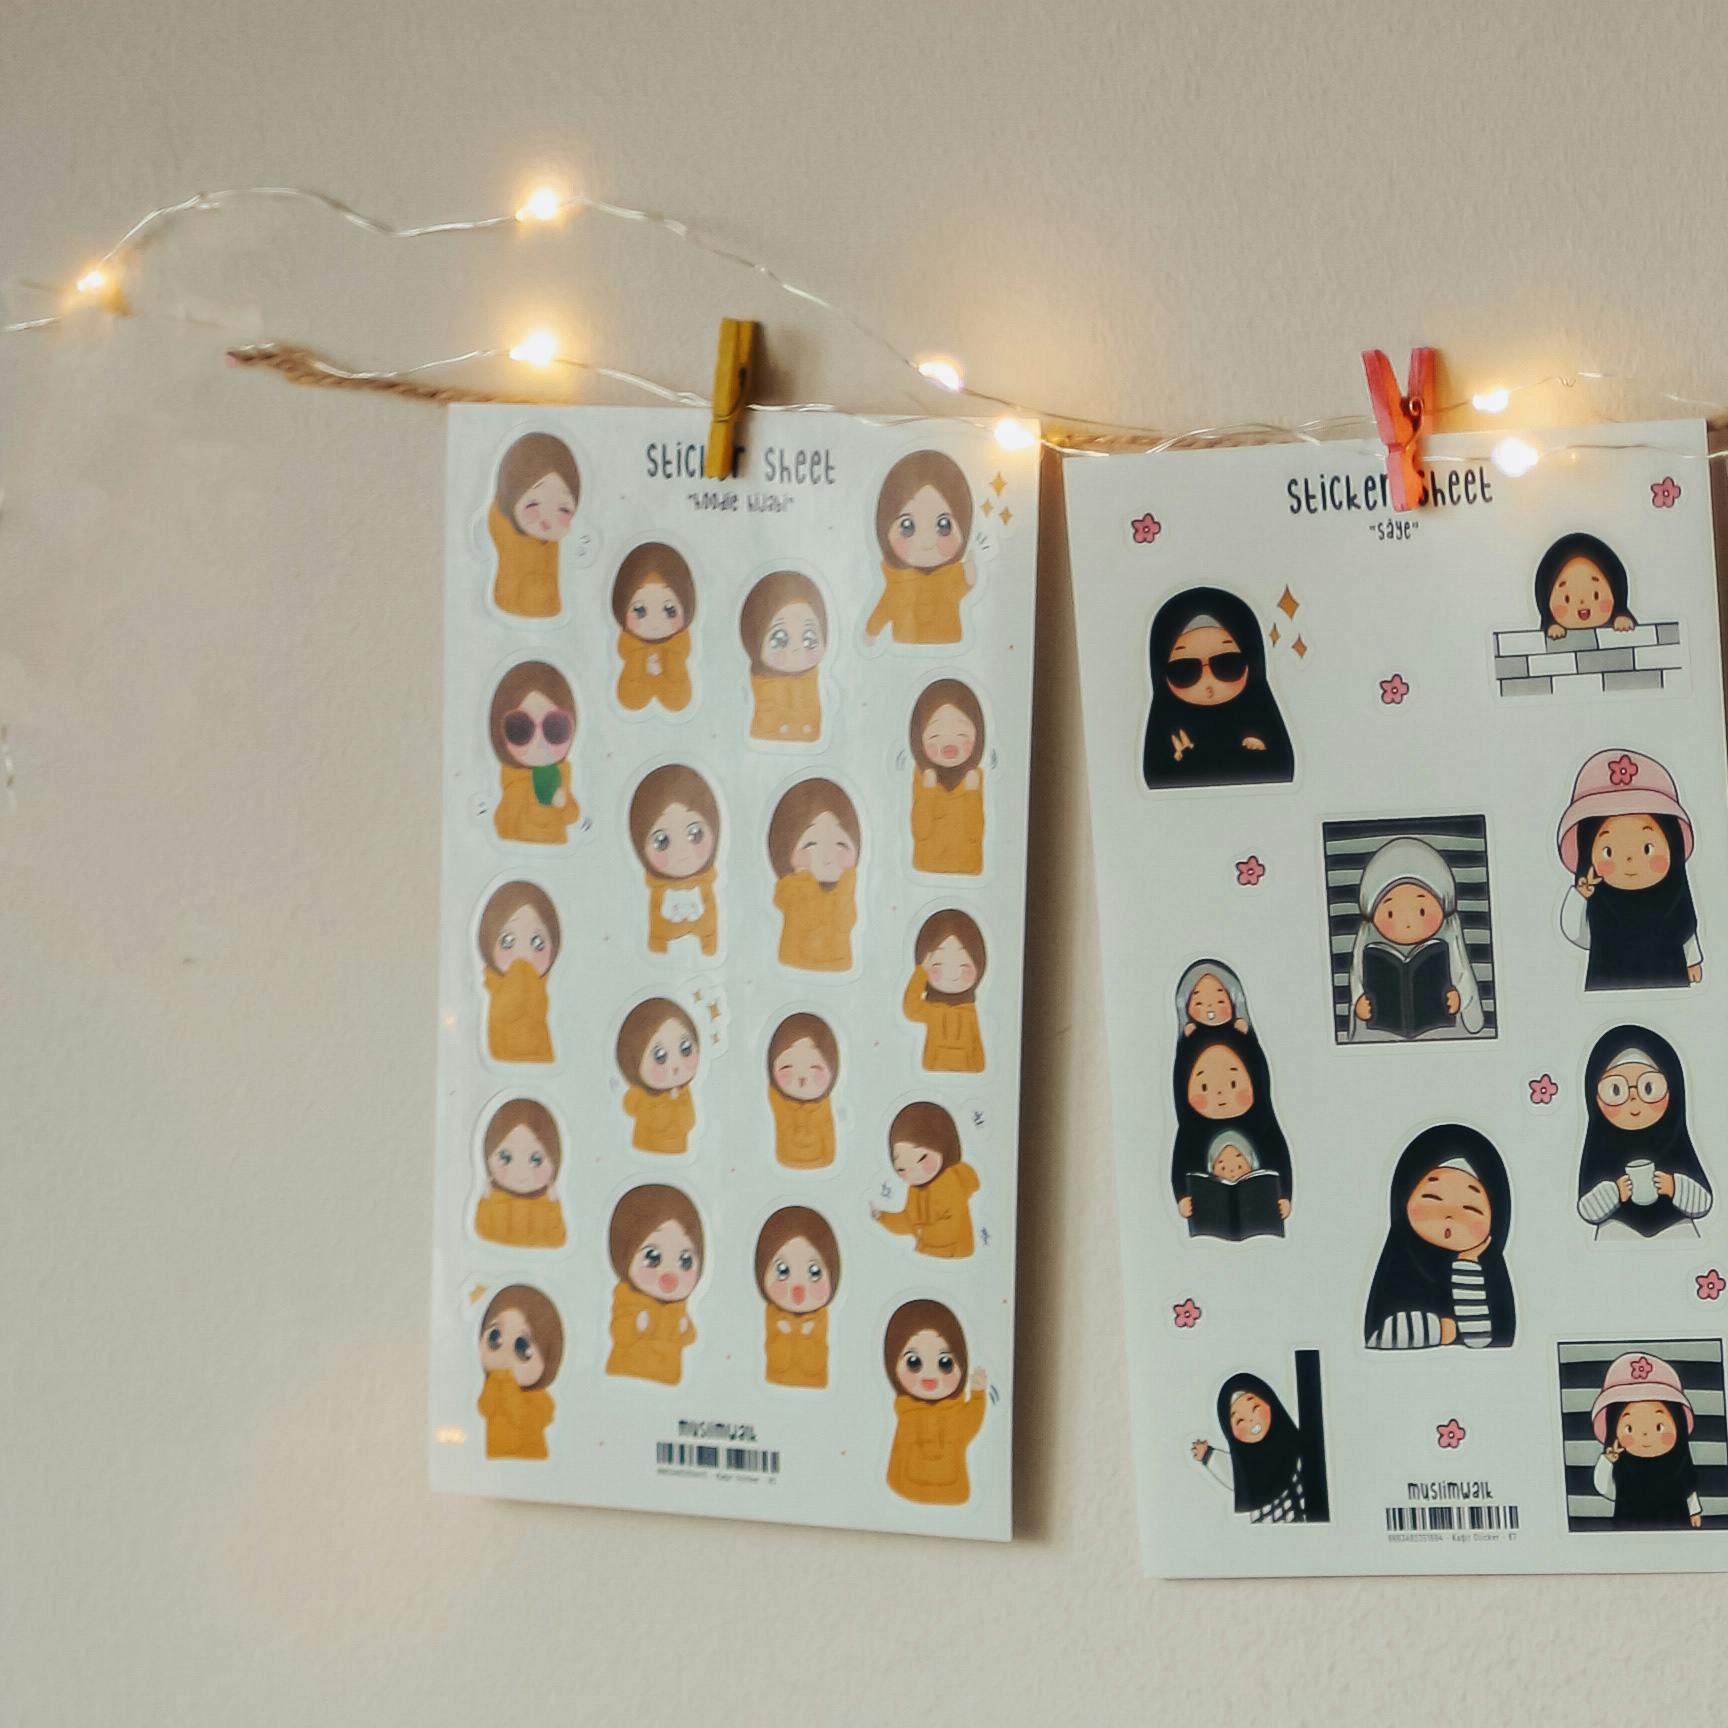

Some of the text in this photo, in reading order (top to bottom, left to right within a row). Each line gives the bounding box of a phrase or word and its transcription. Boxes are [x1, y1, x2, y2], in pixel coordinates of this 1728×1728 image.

[647, 441, 835, 484] Sticr Sheet
[1287, 473, 1389, 514] Sticker
[1407, 1481, 1493, 1501] muslimwalk
